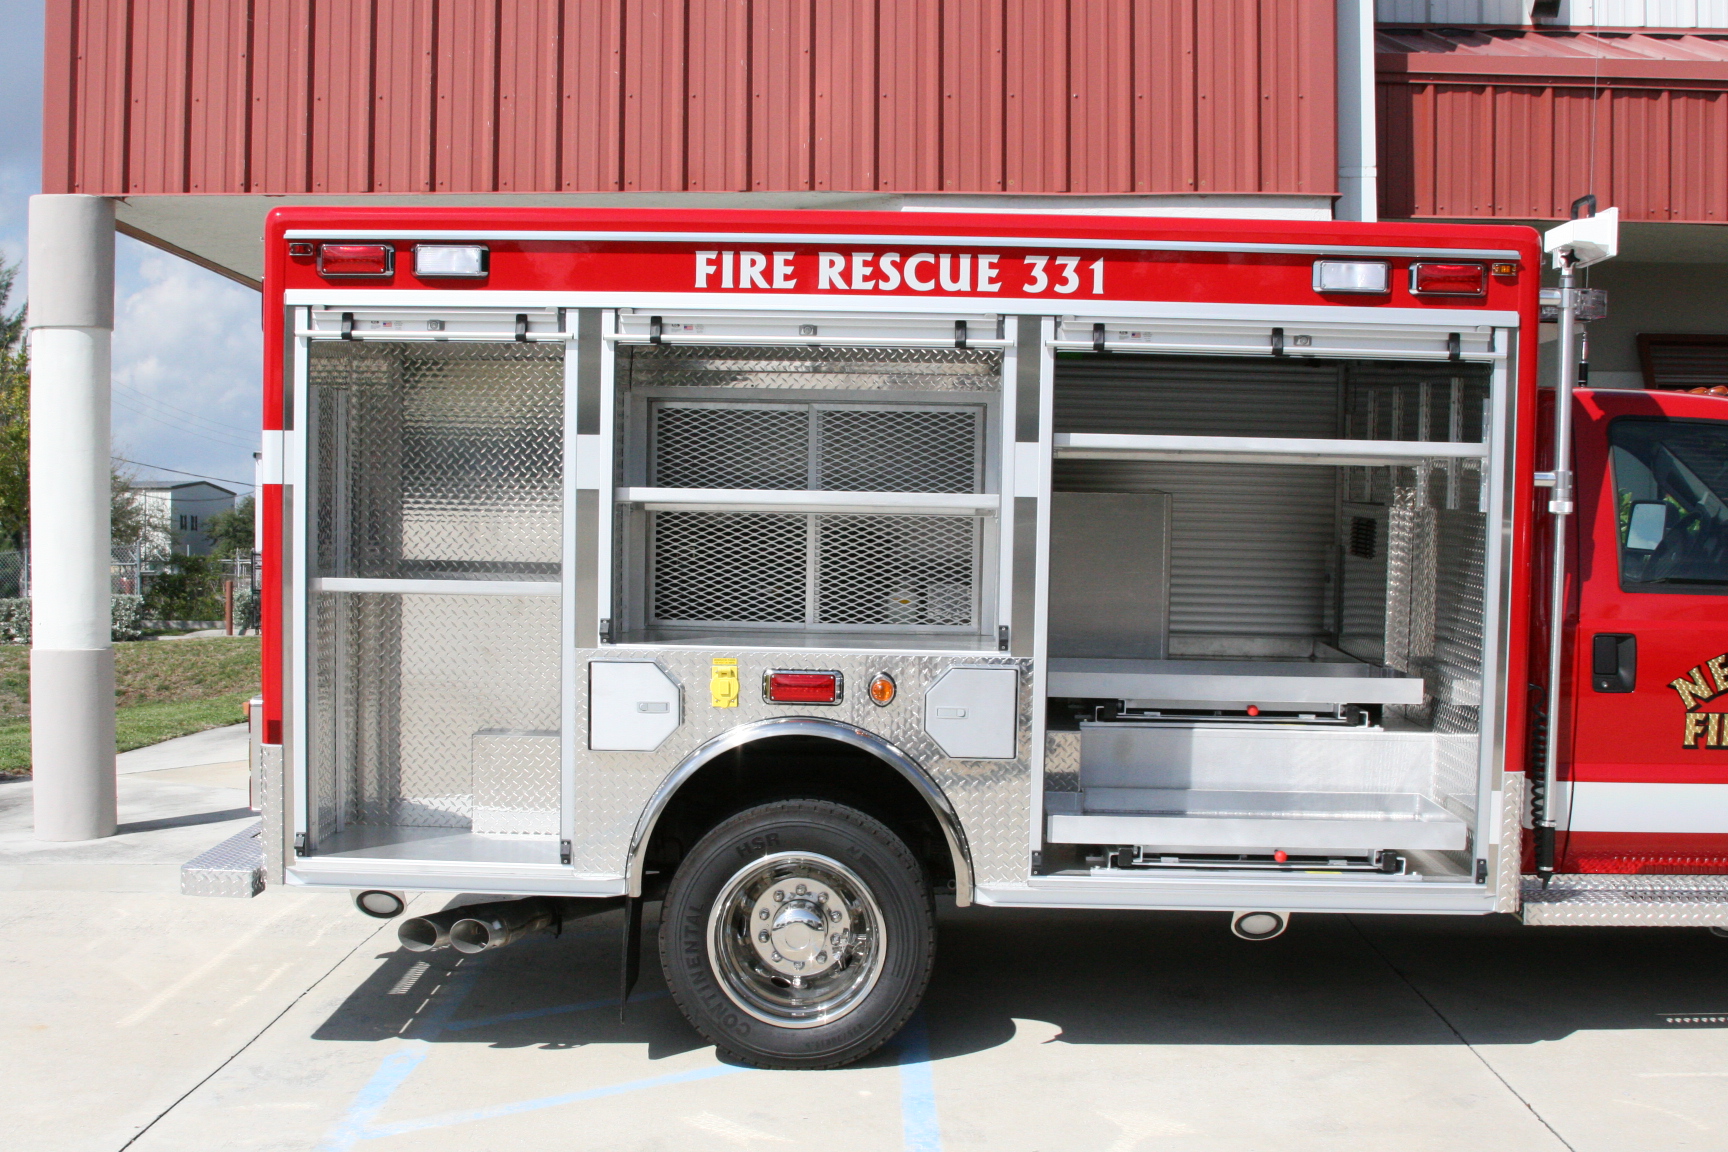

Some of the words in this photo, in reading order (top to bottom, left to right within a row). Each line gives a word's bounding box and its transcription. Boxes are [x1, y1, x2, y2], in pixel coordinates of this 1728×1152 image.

[694, 250, 797, 290] FIRE
[817, 250, 1002, 293] RESCUE
[1022, 254, 1105, 296] 331
[736, 832, 780, 859] HSR
[683, 902, 751, 1038] CONTINENTAL
